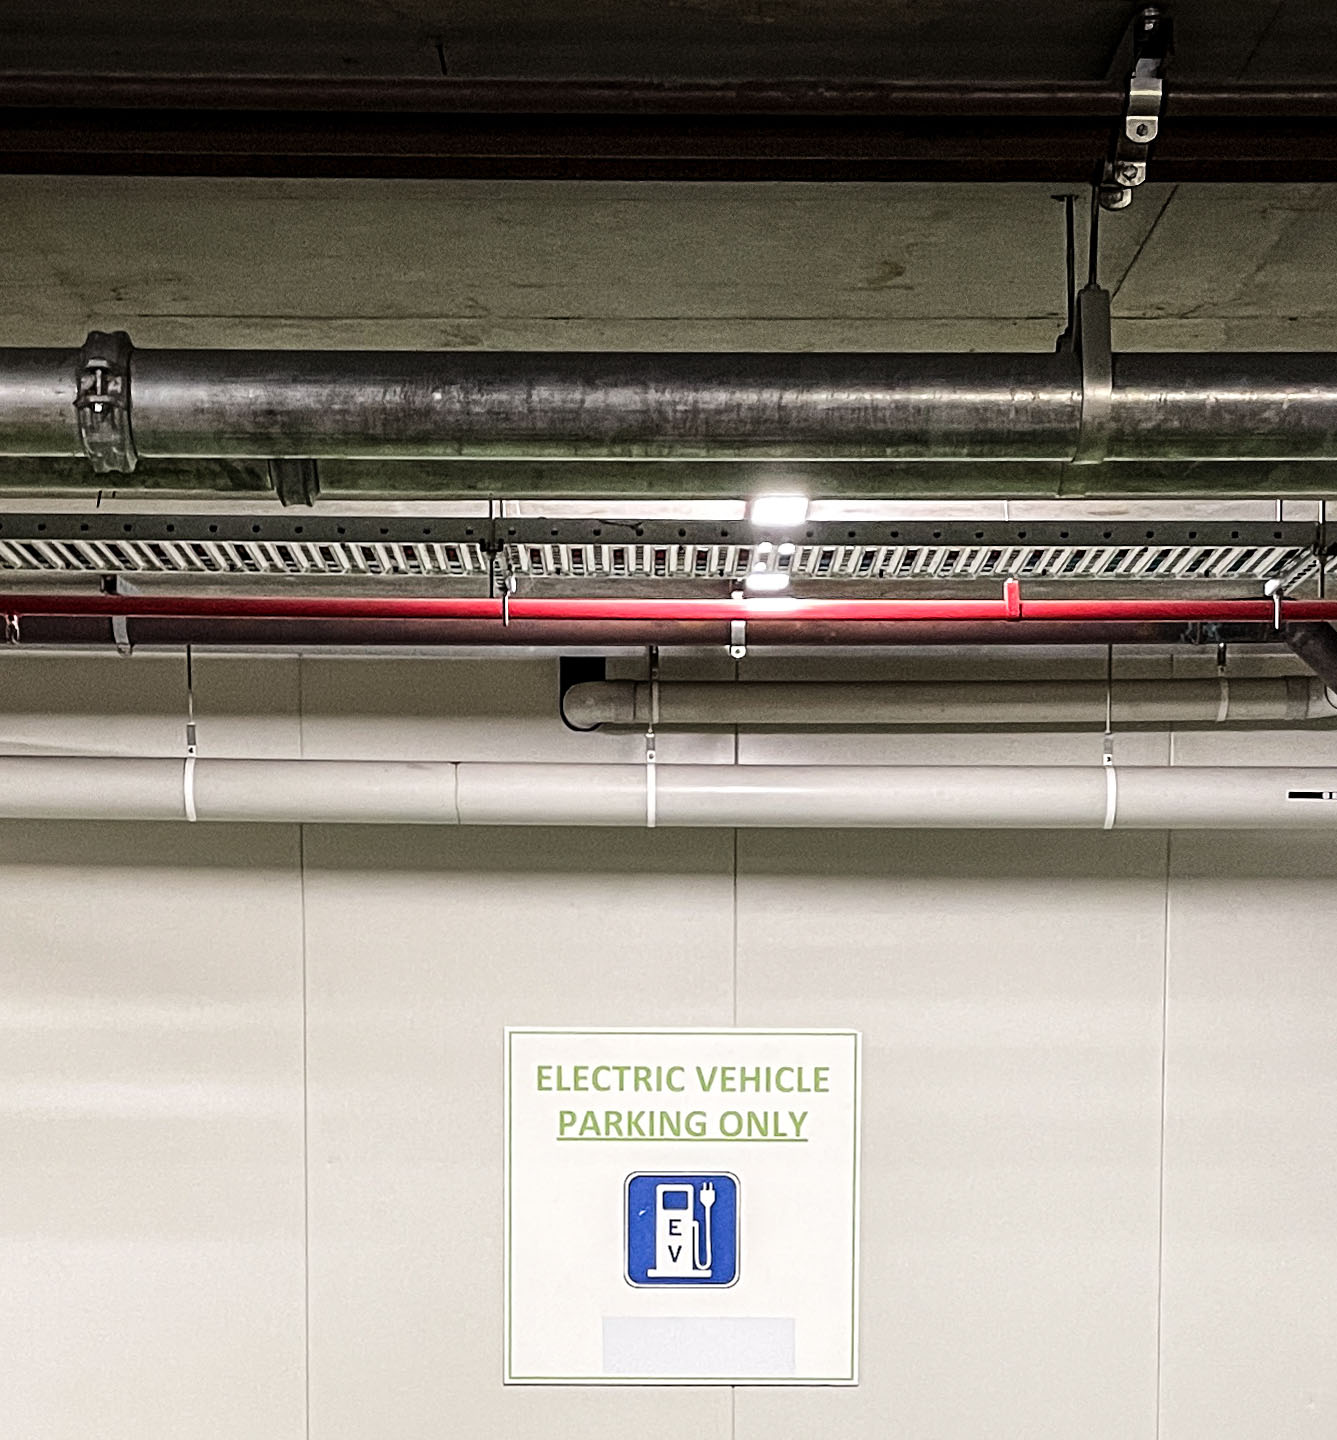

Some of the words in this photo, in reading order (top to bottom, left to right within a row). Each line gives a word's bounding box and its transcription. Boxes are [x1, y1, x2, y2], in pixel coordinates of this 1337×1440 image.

[535, 1064, 685, 1092] ELECTRIC
[695, 1066, 830, 1093] VEHICLE
[558, 1110, 708, 1137] PARKING
[718, 1111, 808, 1138] ONLY
